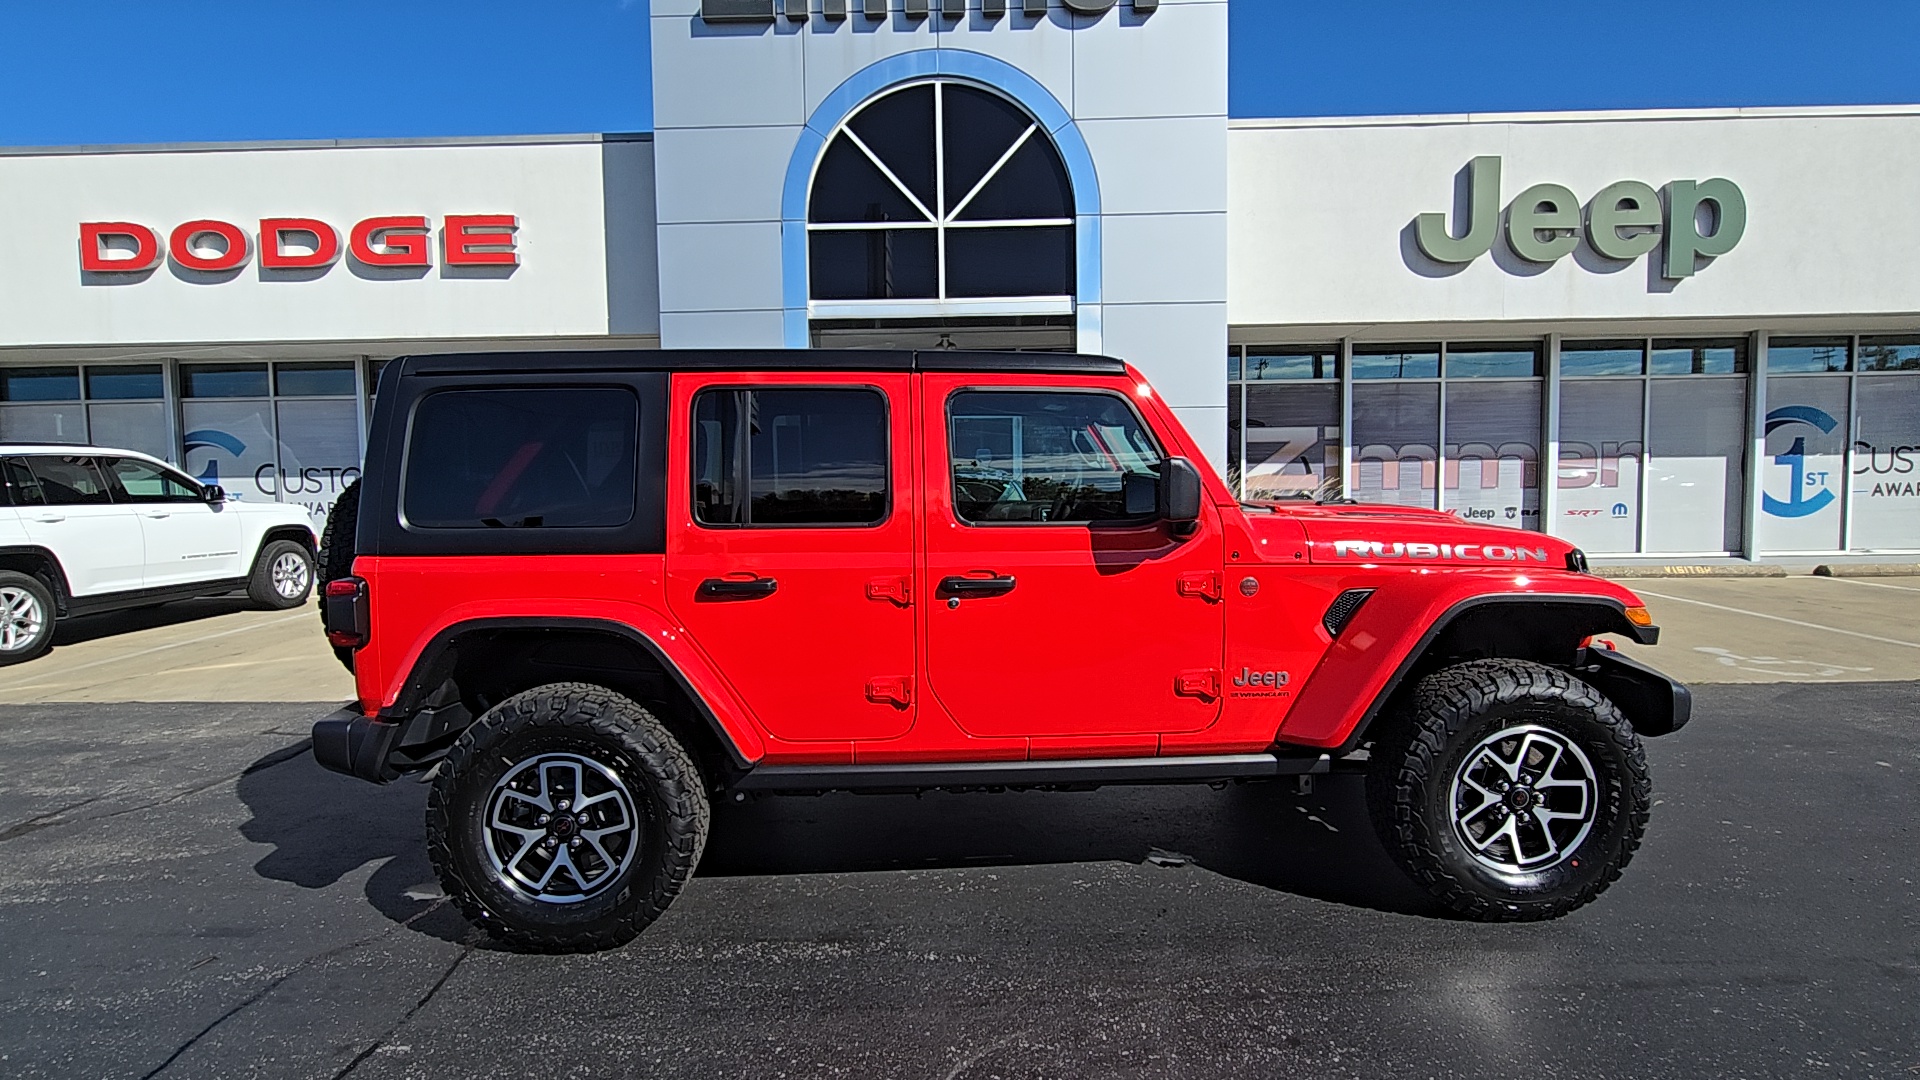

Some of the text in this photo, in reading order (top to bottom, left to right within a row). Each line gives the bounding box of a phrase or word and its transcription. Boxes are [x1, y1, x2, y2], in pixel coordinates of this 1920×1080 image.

[1418, 156, 1747, 278] Jeep
[78, 214, 521, 271] DODGE
[1245, 426, 1652, 490] Zimmer
[1463, 506, 1495, 520] Jeep
[1564, 509, 1603, 518] SRT
[1333, 540, 1548, 562] RUBICON
[1233, 666, 1289, 690] Jeep
